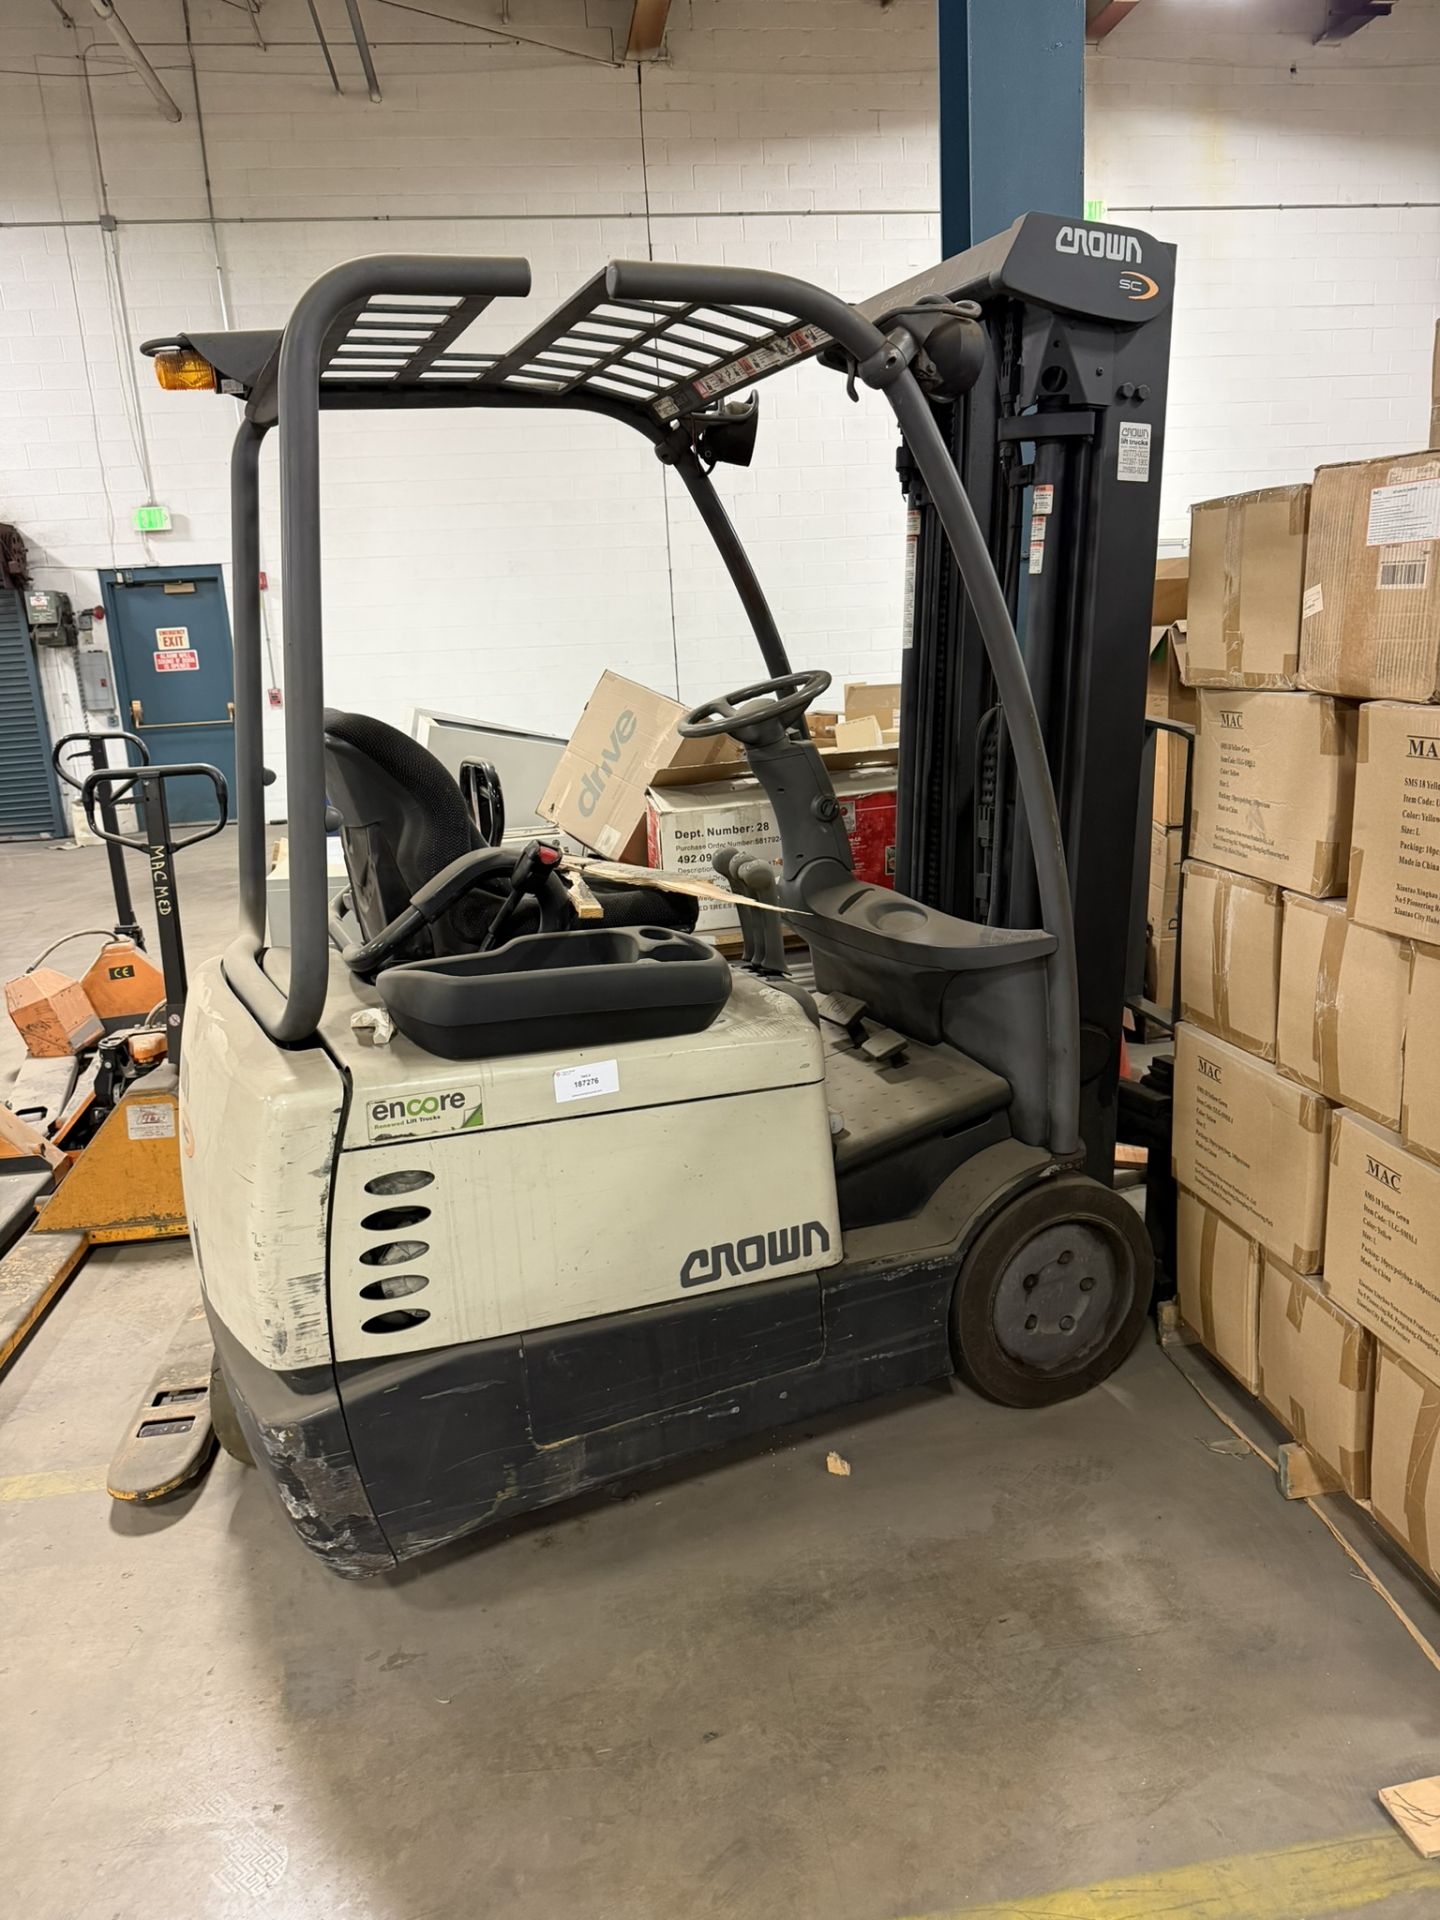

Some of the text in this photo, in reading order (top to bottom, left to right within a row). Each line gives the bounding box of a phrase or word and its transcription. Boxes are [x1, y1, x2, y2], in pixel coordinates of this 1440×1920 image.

[1055, 226, 1143, 264] CROWN
[1119, 279, 1143, 291] SC
[162, 635, 184, 648] EXIT
[1221, 713, 1243, 729] MAC
[1409, 738, 1439, 757] MA
[578, 708, 637, 818] drive
[675, 821, 770, 840] Dept. Number: 28
[150, 845, 167, 882] MAC
[1199, 1059, 1221, 1081] MAC
[1367, 1159, 1400, 1190] MAC
[680, 1220, 830, 1288] CROWN
